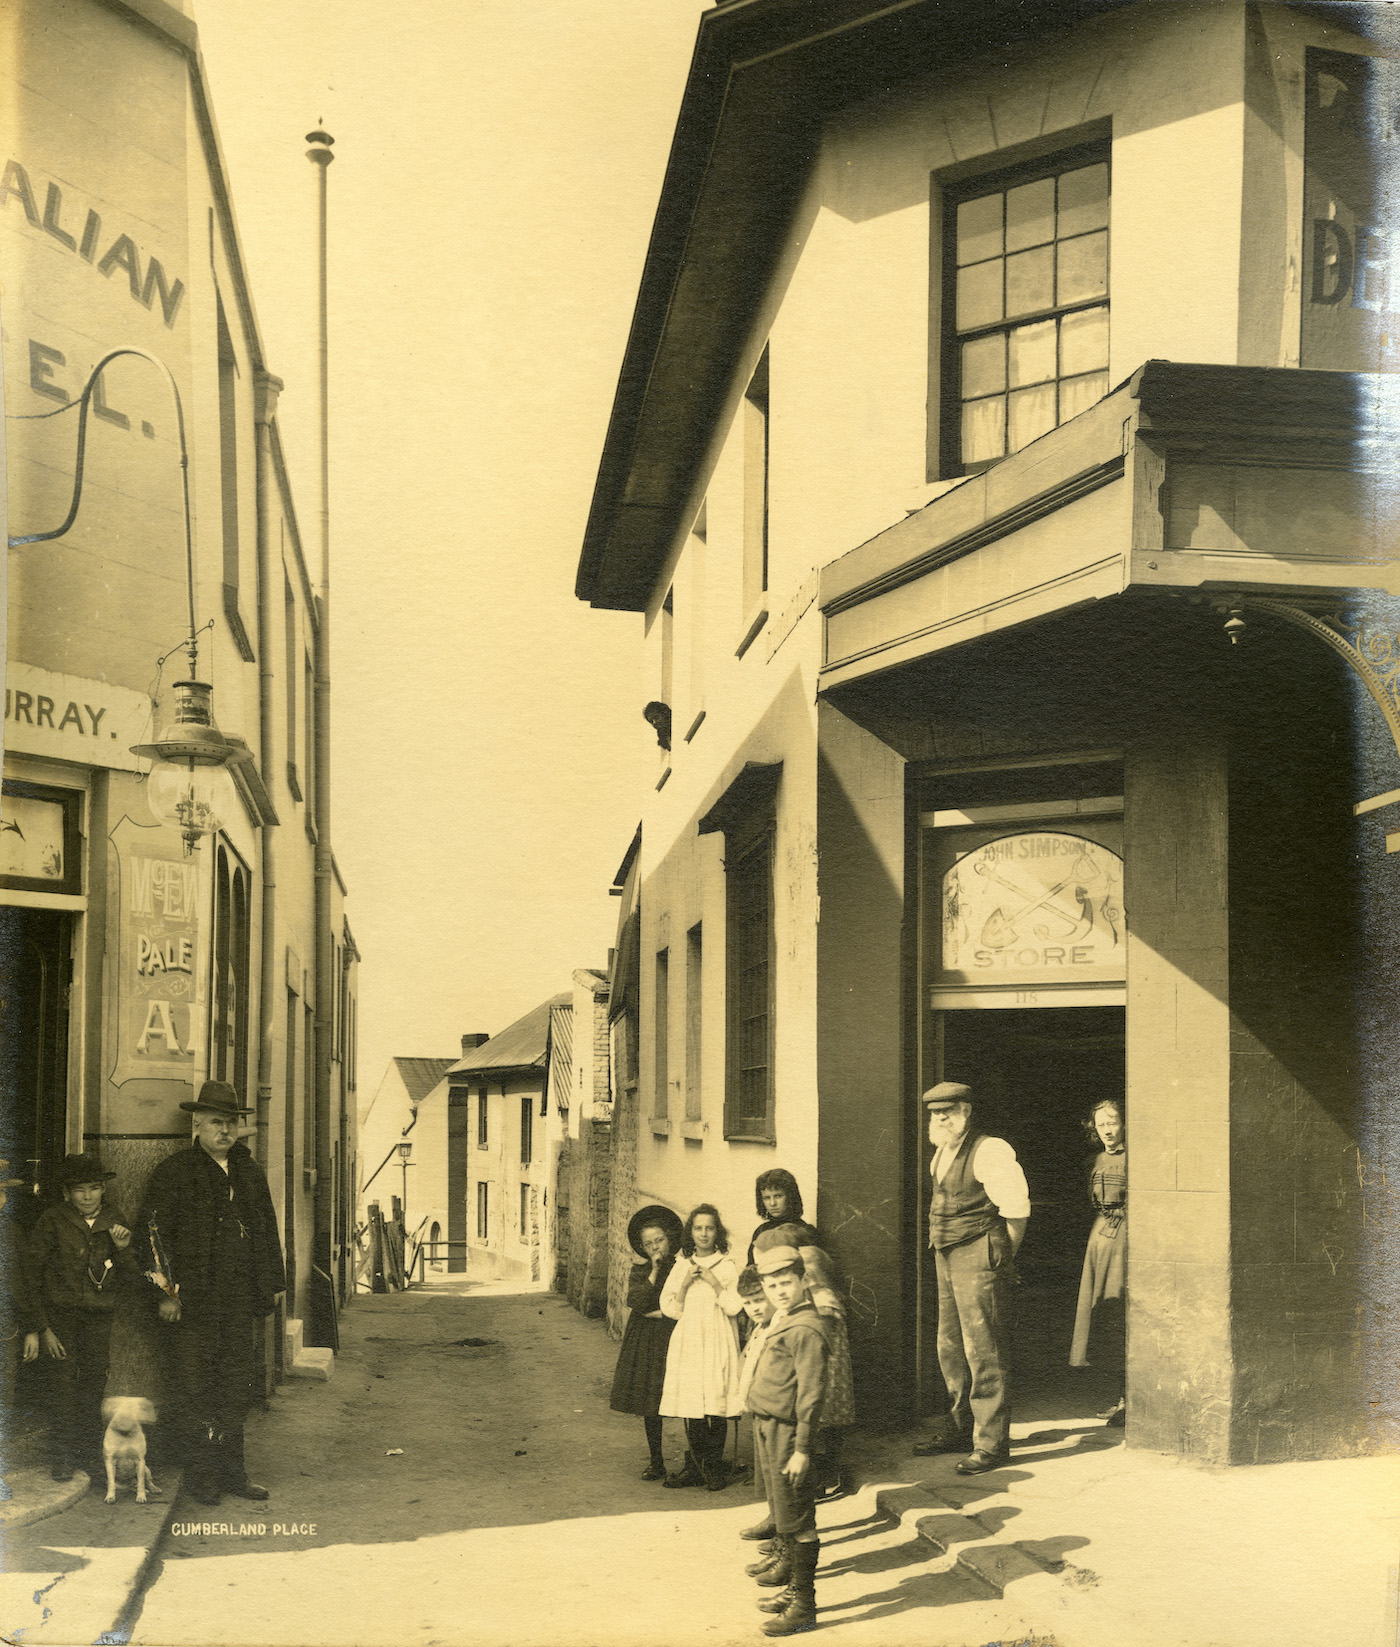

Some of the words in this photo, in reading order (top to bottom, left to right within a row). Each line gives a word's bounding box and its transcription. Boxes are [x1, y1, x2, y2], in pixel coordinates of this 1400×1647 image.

[1, 159, 185, 330] ALIAN
[2, 328, 155, 440] EL.
[979, 841, 1013, 862] JOHN
[137, 933, 192, 977] PALE
[973, 945, 1095, 968] STORE
